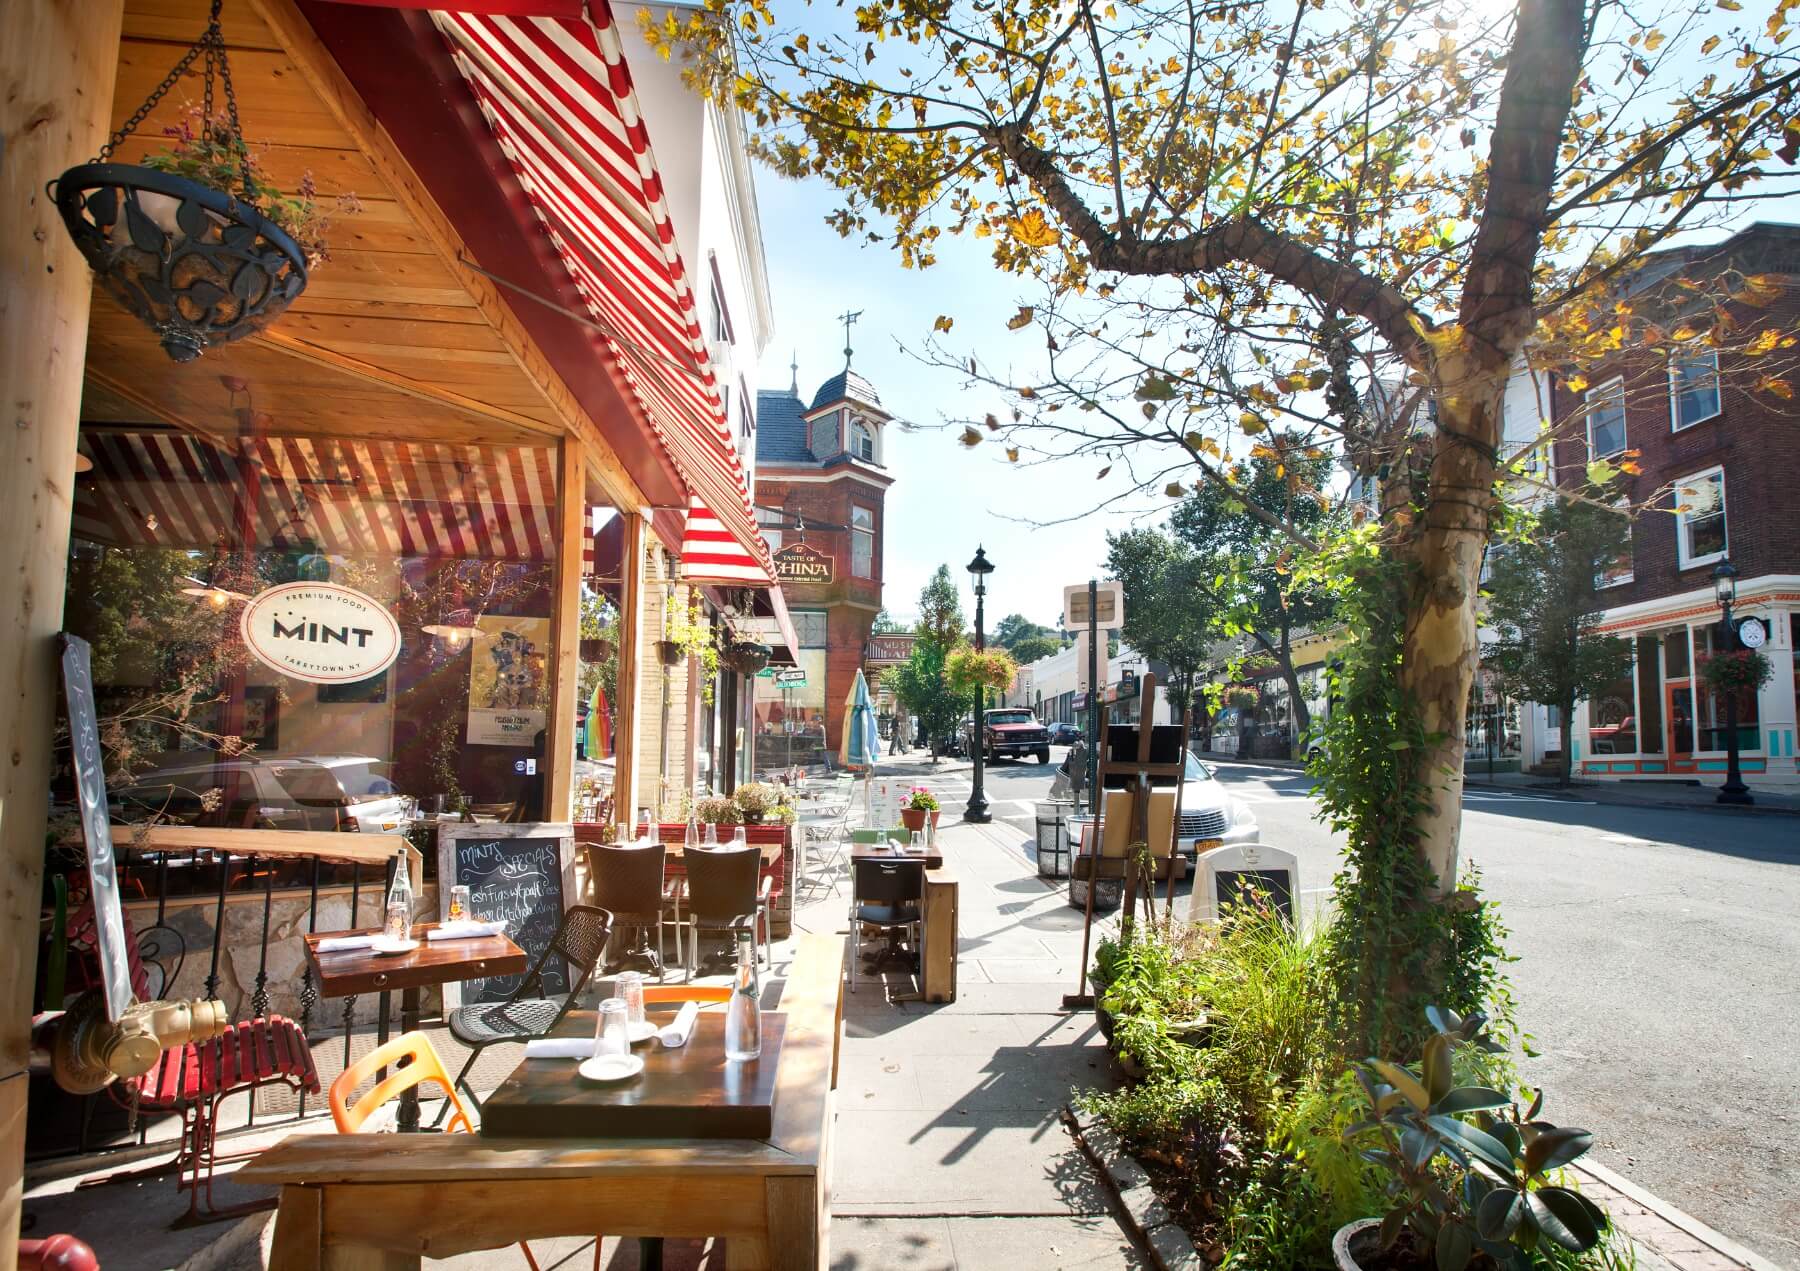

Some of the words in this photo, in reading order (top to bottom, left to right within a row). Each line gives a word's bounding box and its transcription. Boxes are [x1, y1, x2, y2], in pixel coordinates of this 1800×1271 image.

[285, 592, 332, 601] PREMIUM
[336, 596, 367, 613] FOODS
[273, 618, 374, 648] MINT
[284, 655, 344, 672] TARRYTOWN
